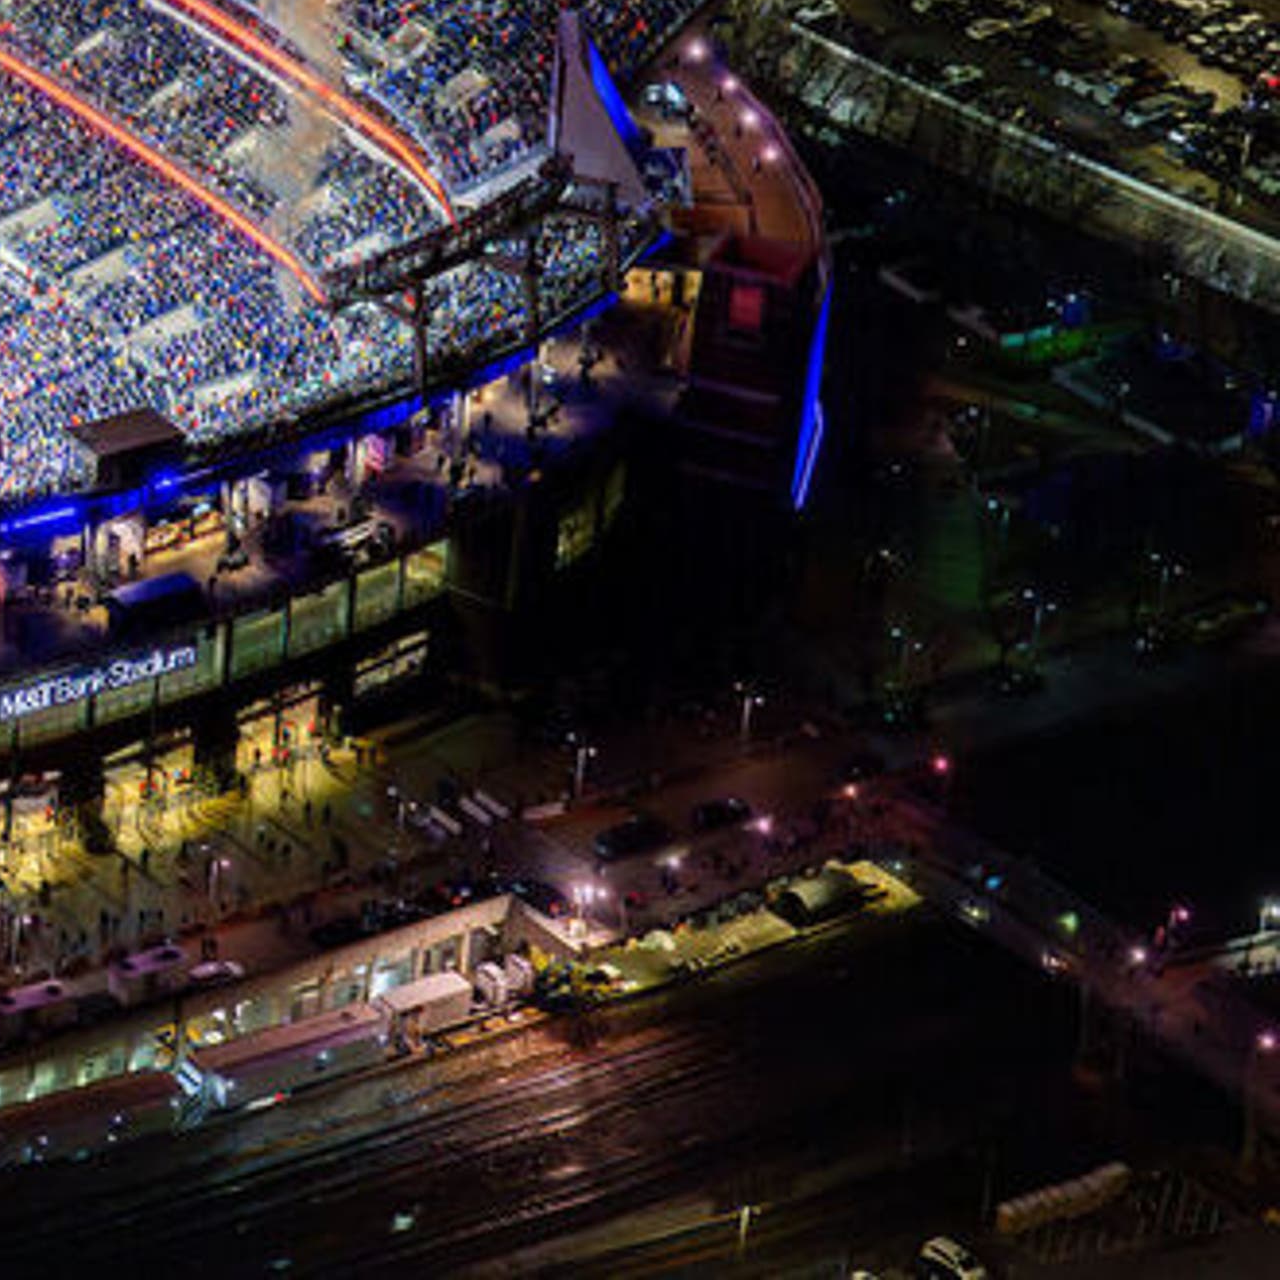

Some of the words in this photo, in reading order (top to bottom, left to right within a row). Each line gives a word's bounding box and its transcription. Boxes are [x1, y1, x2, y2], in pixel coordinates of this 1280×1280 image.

[0, 681, 52, 721] M&T
[54, 670, 105, 704] Bank
[106, 646, 196, 689] Stadium
